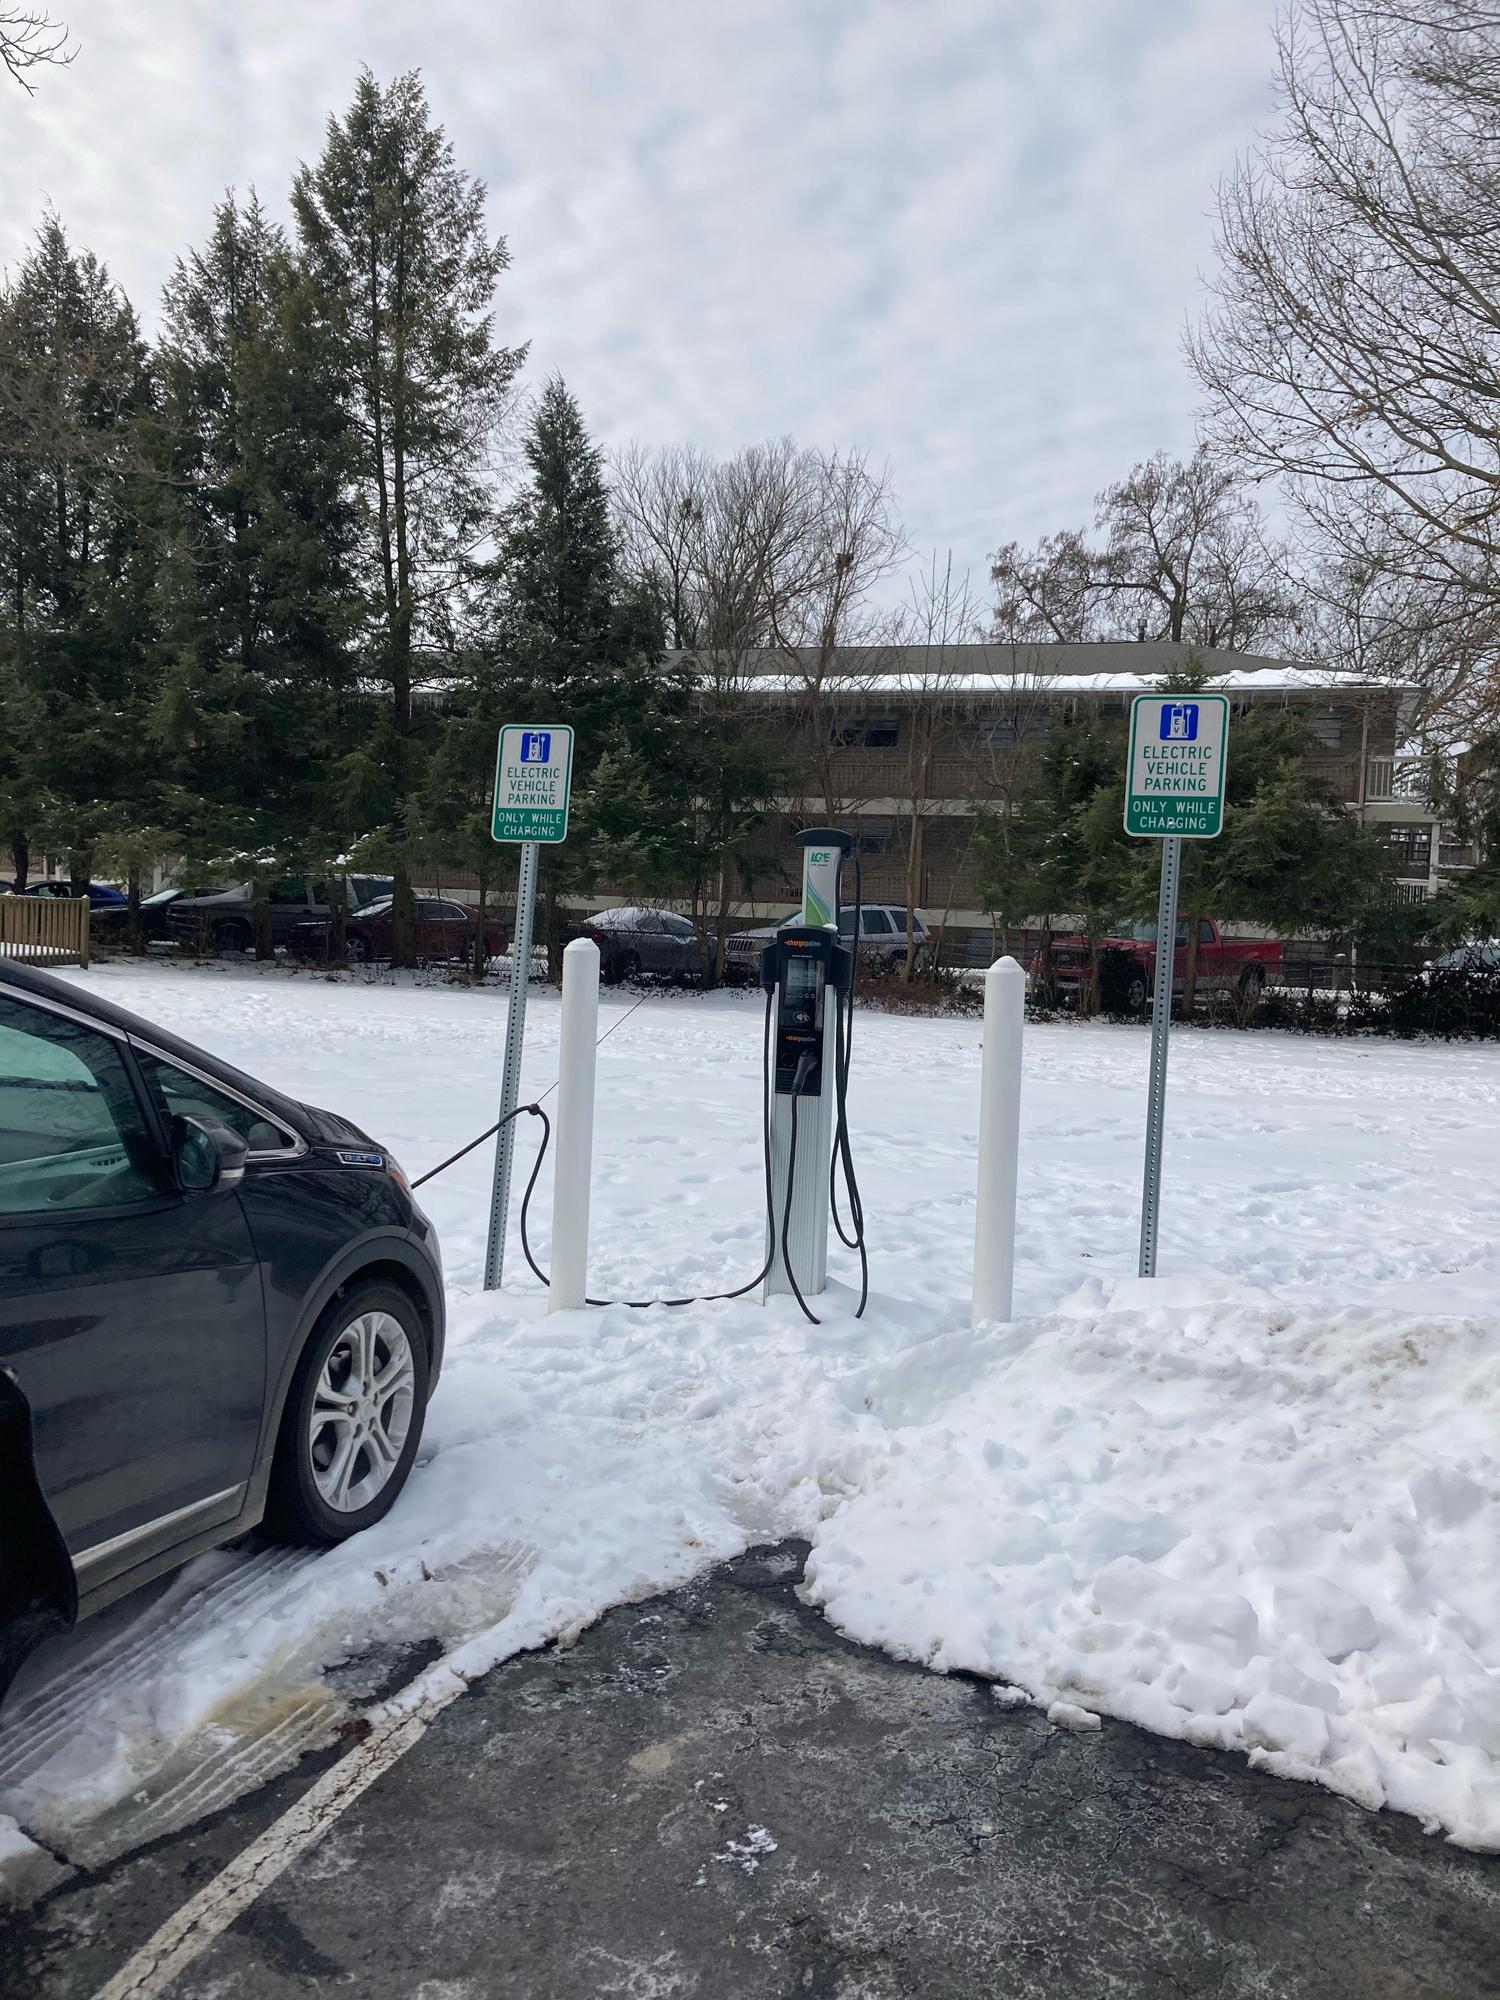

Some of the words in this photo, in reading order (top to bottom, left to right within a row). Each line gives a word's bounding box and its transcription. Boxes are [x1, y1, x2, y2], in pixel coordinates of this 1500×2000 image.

[1143, 746, 1212, 759] ELECTRIC
[507, 767, 560, 779] ELECTRIC
[1147, 762, 1207, 775] VEHICLE
[510, 780, 556, 792] VEHICLE
[1144, 778, 1206, 791] PARKING
[508, 794, 556, 806] PARKING
[1133, 801, 1167, 813] ONLY
[1175, 802, 1216, 814] WHILE
[499, 812, 525, 823] ONLY
[531, 813, 562, 824] WHILE
[503, 825, 555, 837] CHARGING
